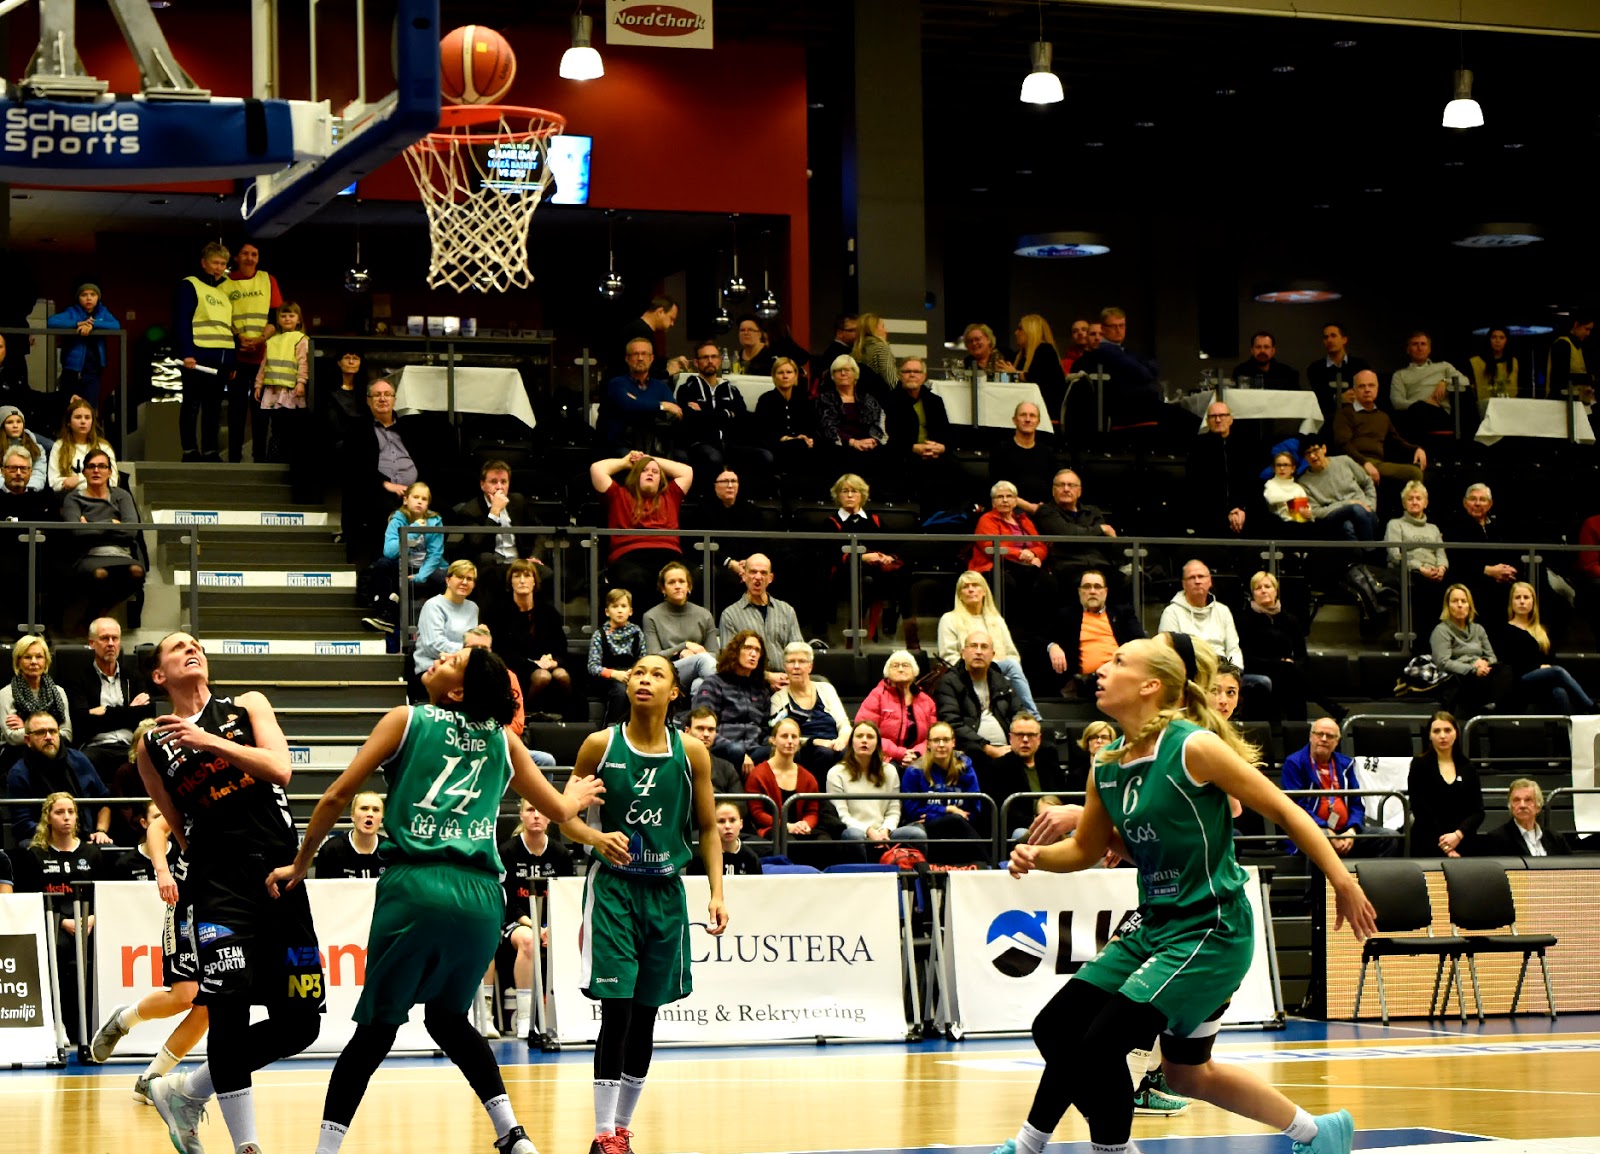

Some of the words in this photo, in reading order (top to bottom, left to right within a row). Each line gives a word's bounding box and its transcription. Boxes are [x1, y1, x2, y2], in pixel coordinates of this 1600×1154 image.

[613, 12, 705, 29] NordChark
[6, 108, 139, 132] Schelde
[4, 130, 140, 159] Sports
[518, 150, 539, 161] DAY
[445, 727, 487, 752] Skåne
[413, 755, 488, 815] 14
[634, 767, 658, 796] 4
[1122, 775, 1142, 815] 6
[625, 800, 663, 826] Eos
[411, 820, 437, 837] LKF
[439, 825, 463, 839] LKF
[468, 823, 494, 839] LKF
[1123, 818, 1160, 844] Eos
[64, 861, 71, 873] 6
[530, 865, 541, 877] 15
[288, 974, 321, 999] NP3
[714, 1004, 731, 1021] &
[738, 1003, 867, 1024] Rekrytering
